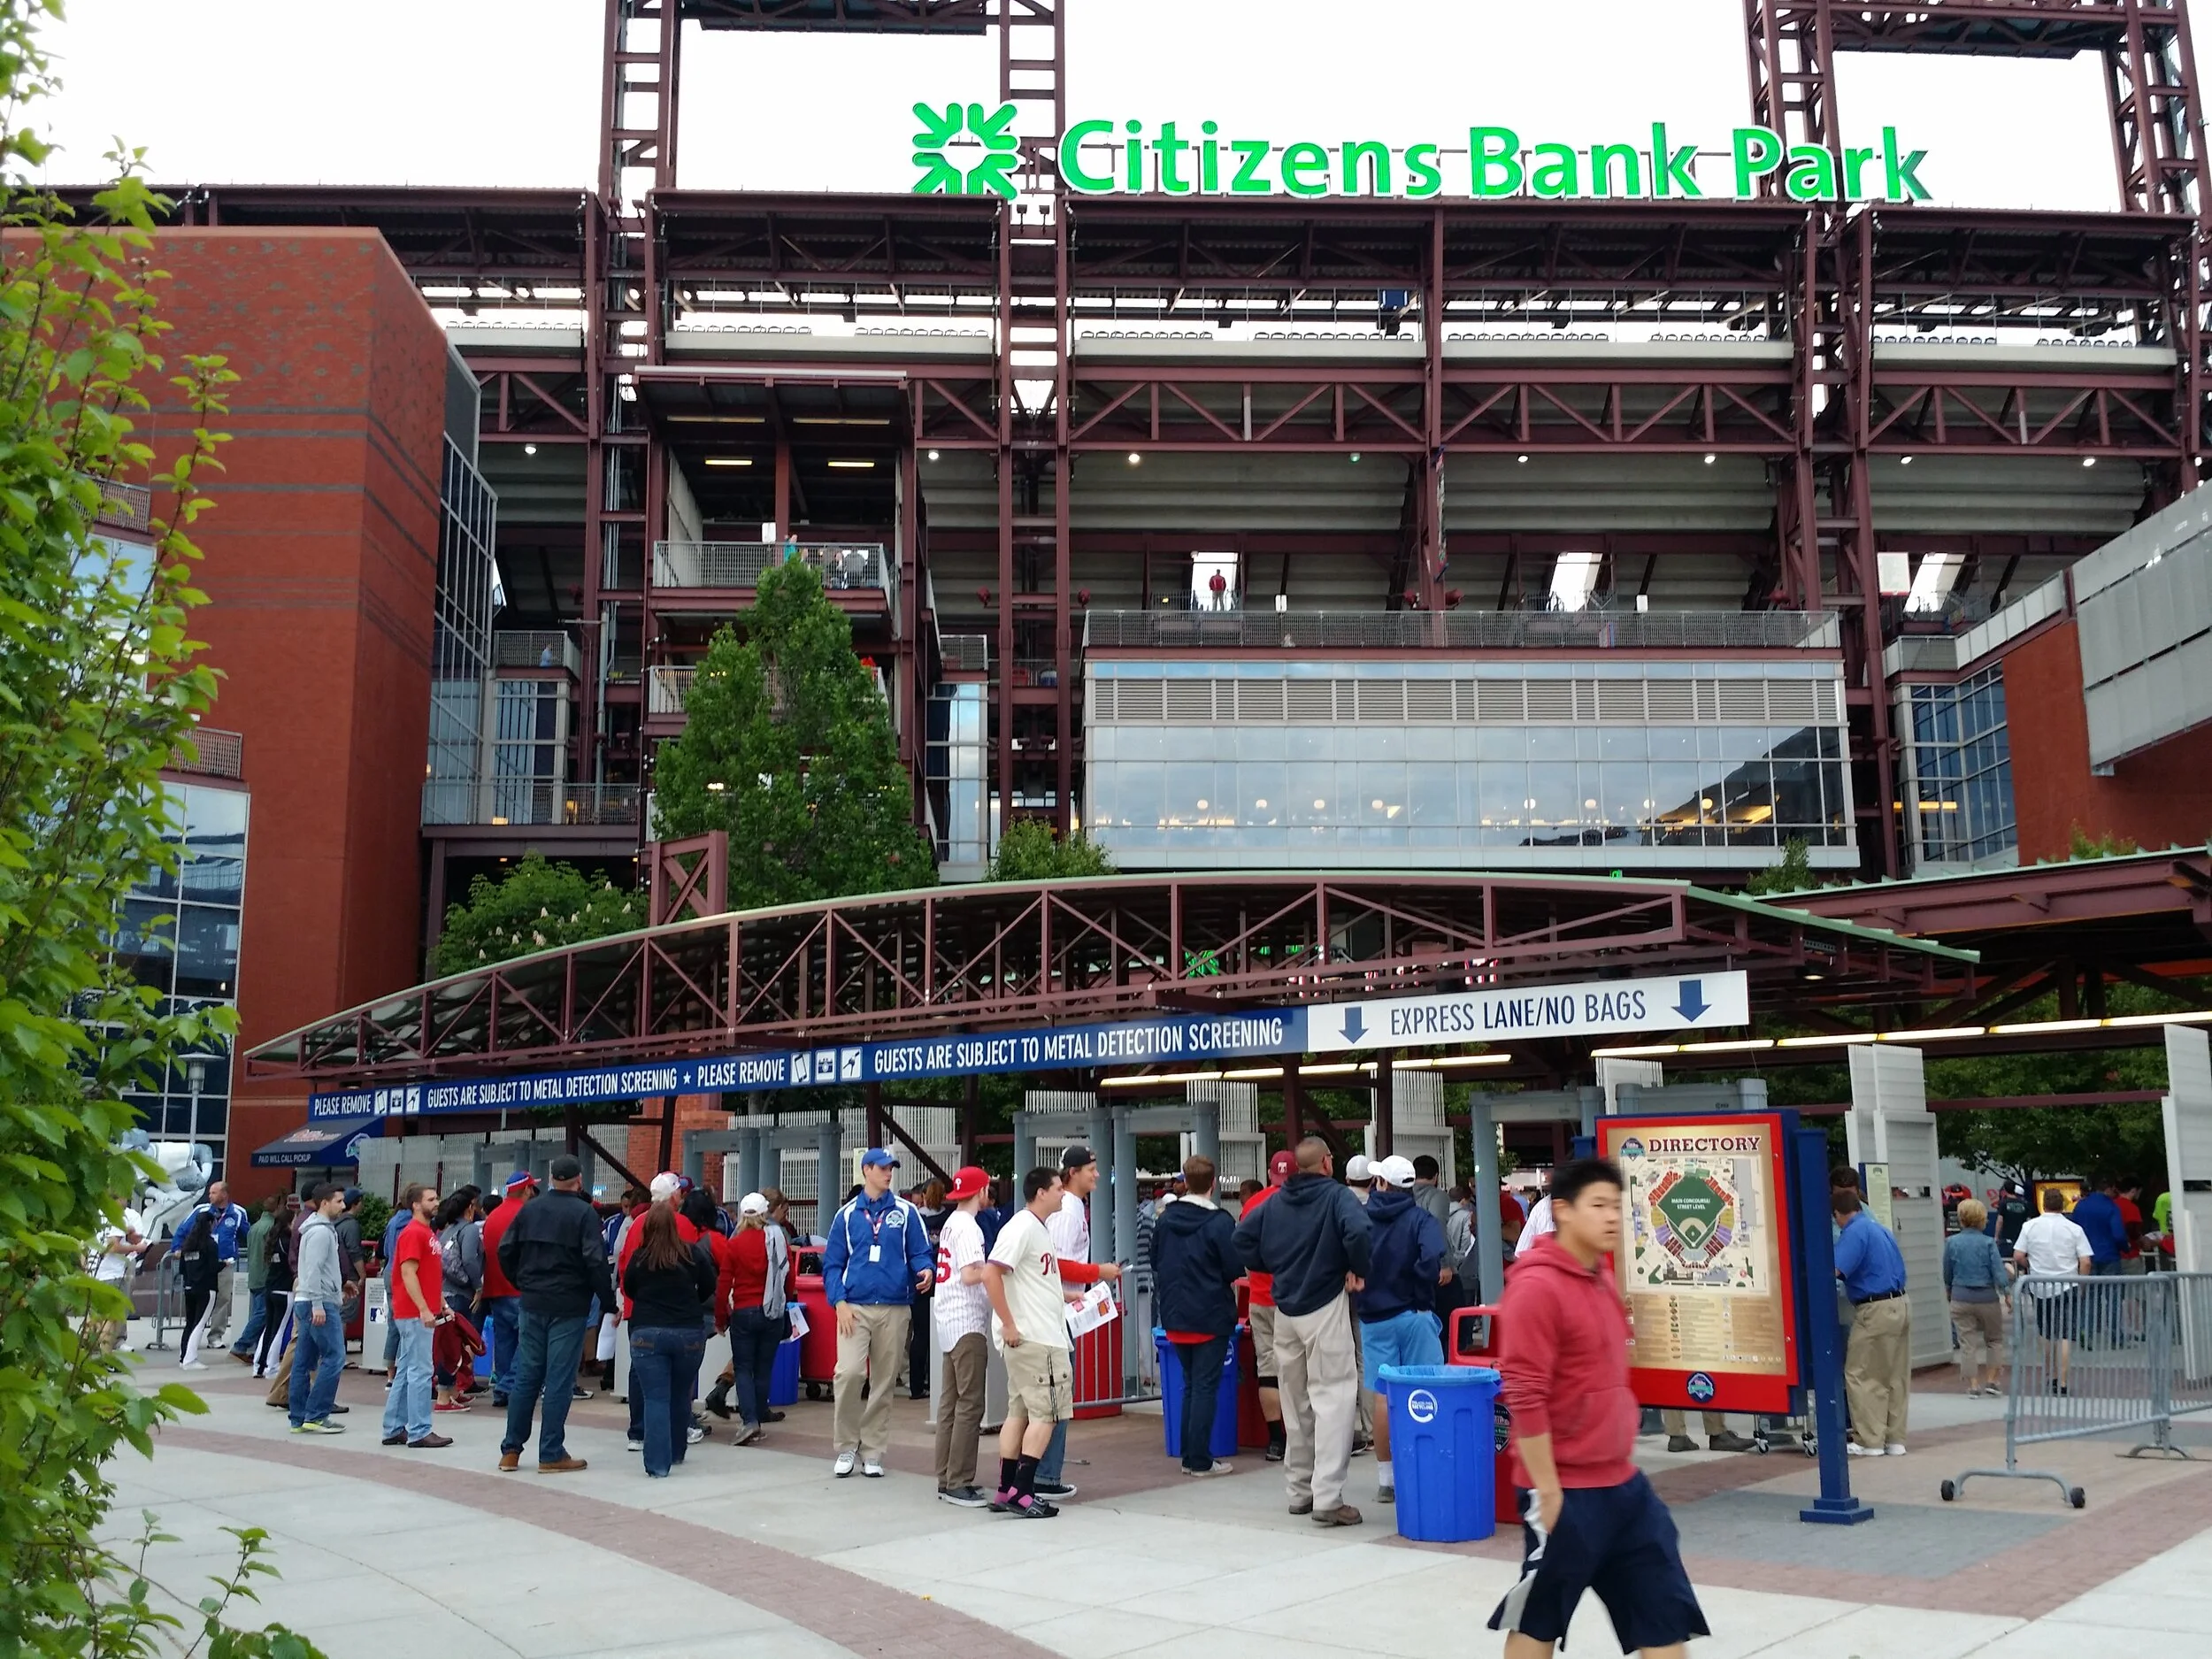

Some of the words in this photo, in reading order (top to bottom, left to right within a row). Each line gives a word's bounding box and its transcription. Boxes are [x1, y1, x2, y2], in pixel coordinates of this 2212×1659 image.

[1060, 119, 1443, 197] Citizens
[1468, 122, 1704, 197] Bank
[1732, 126, 1935, 201] Park
[1390, 1002, 1475, 1036] EXPRESS
[1483, 995, 1576, 1030] LANE/NO
[1585, 989, 1647, 1023] BAGS
[874, 1046, 923, 1074] GUESTS
[926, 1044, 953, 1071] ARE
[956, 1038, 1018, 1068] SUBJECT
[1021, 1036, 1040, 1063] TO
[1044, 1032, 1093, 1062] METAL
[1097, 1025, 1183, 1057] DETECTION
[1188, 1017, 1283, 1052] SCREENING
[426, 1087, 458, 1109] GUESTS
[459, 1086, 478, 1106] ARE
[478, 1082, 517, 1104] SUBJECT
[518, 1080, 532, 1102] TO
[533, 1077, 564, 1100] METAL
[565, 1072, 619, 1098] DETECTION
[620, 1067, 677, 1094] SCREENING
[697, 1063, 736, 1087] PLEASE
[739, 1058, 786, 1084] REMOVE
[314, 1096, 340, 1117] PLEASE
[341, 1094, 372, 1114] REMOVE
[258, 1155, 270, 1164] PAID
[270, 1154, 280, 1164] WILL
[280, 1154, 293, 1163] CALL
[294, 1153, 311, 1163] PICKUP
[1648, 1137, 1761, 1152] DIRECTORY
